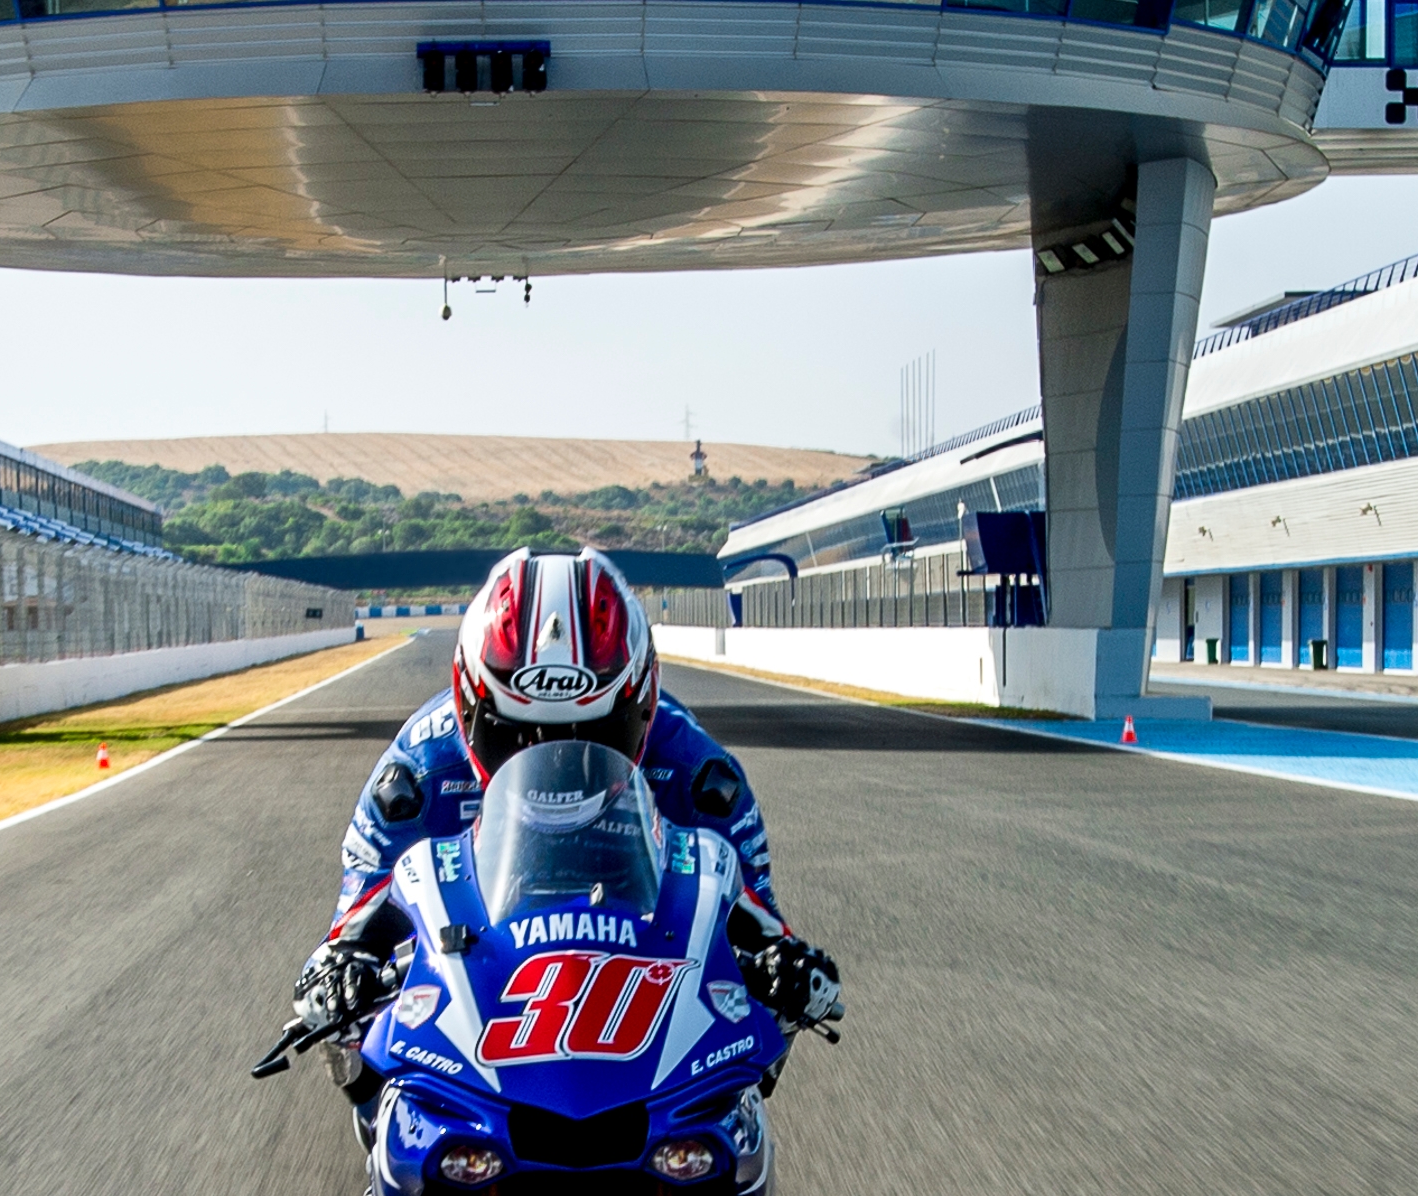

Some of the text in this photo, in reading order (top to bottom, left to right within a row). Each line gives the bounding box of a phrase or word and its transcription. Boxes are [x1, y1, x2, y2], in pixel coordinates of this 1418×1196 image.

[520, 668, 586, 691] Arai
[509, 913, 637, 949] YAMAHA
[475, 949, 701, 1068] 30
[389, 1040, 463, 1075] E. CASTRO
[691, 1035, 754, 1076] E. CASTRO
